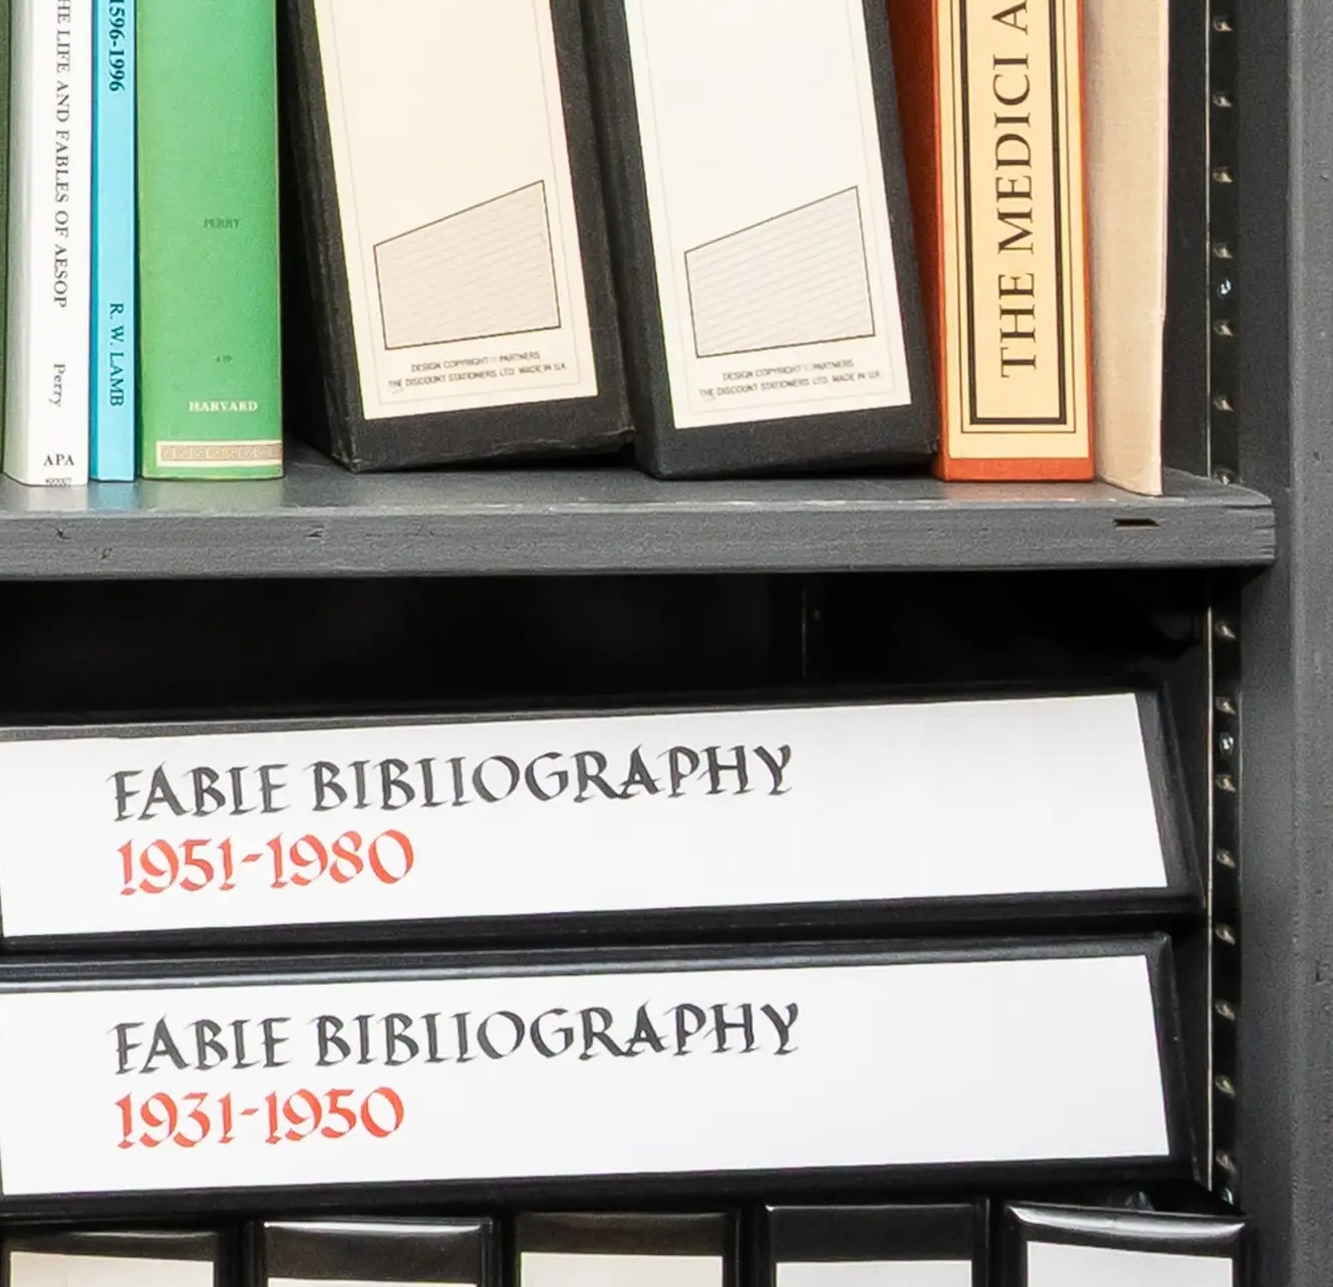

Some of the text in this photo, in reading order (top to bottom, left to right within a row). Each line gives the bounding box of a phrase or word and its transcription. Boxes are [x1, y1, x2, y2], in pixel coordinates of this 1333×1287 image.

[57, 31, 70, 72] LIFE
[57, 81, 69, 122] AND
[56, 131, 69, 202] FABLES
[993, 56, 1033, 253] MEDICI
[55, 211, 68, 237] OF
[54, 245, 67, 307] AESOP
[109, 303, 125, 406] R. W. LAMB
[998, 274, 1036, 377] THE
[189, 401, 257, 412] HARVARD
[112, 745, 791, 821] FABLE BIBLIOGRAPHY
[117, 829, 414, 895] 1951-1980
[114, 1003, 798, 1074] FABLE BIBLIOGRAPHY
[115, 1087, 404, 1149] 1931-1950
